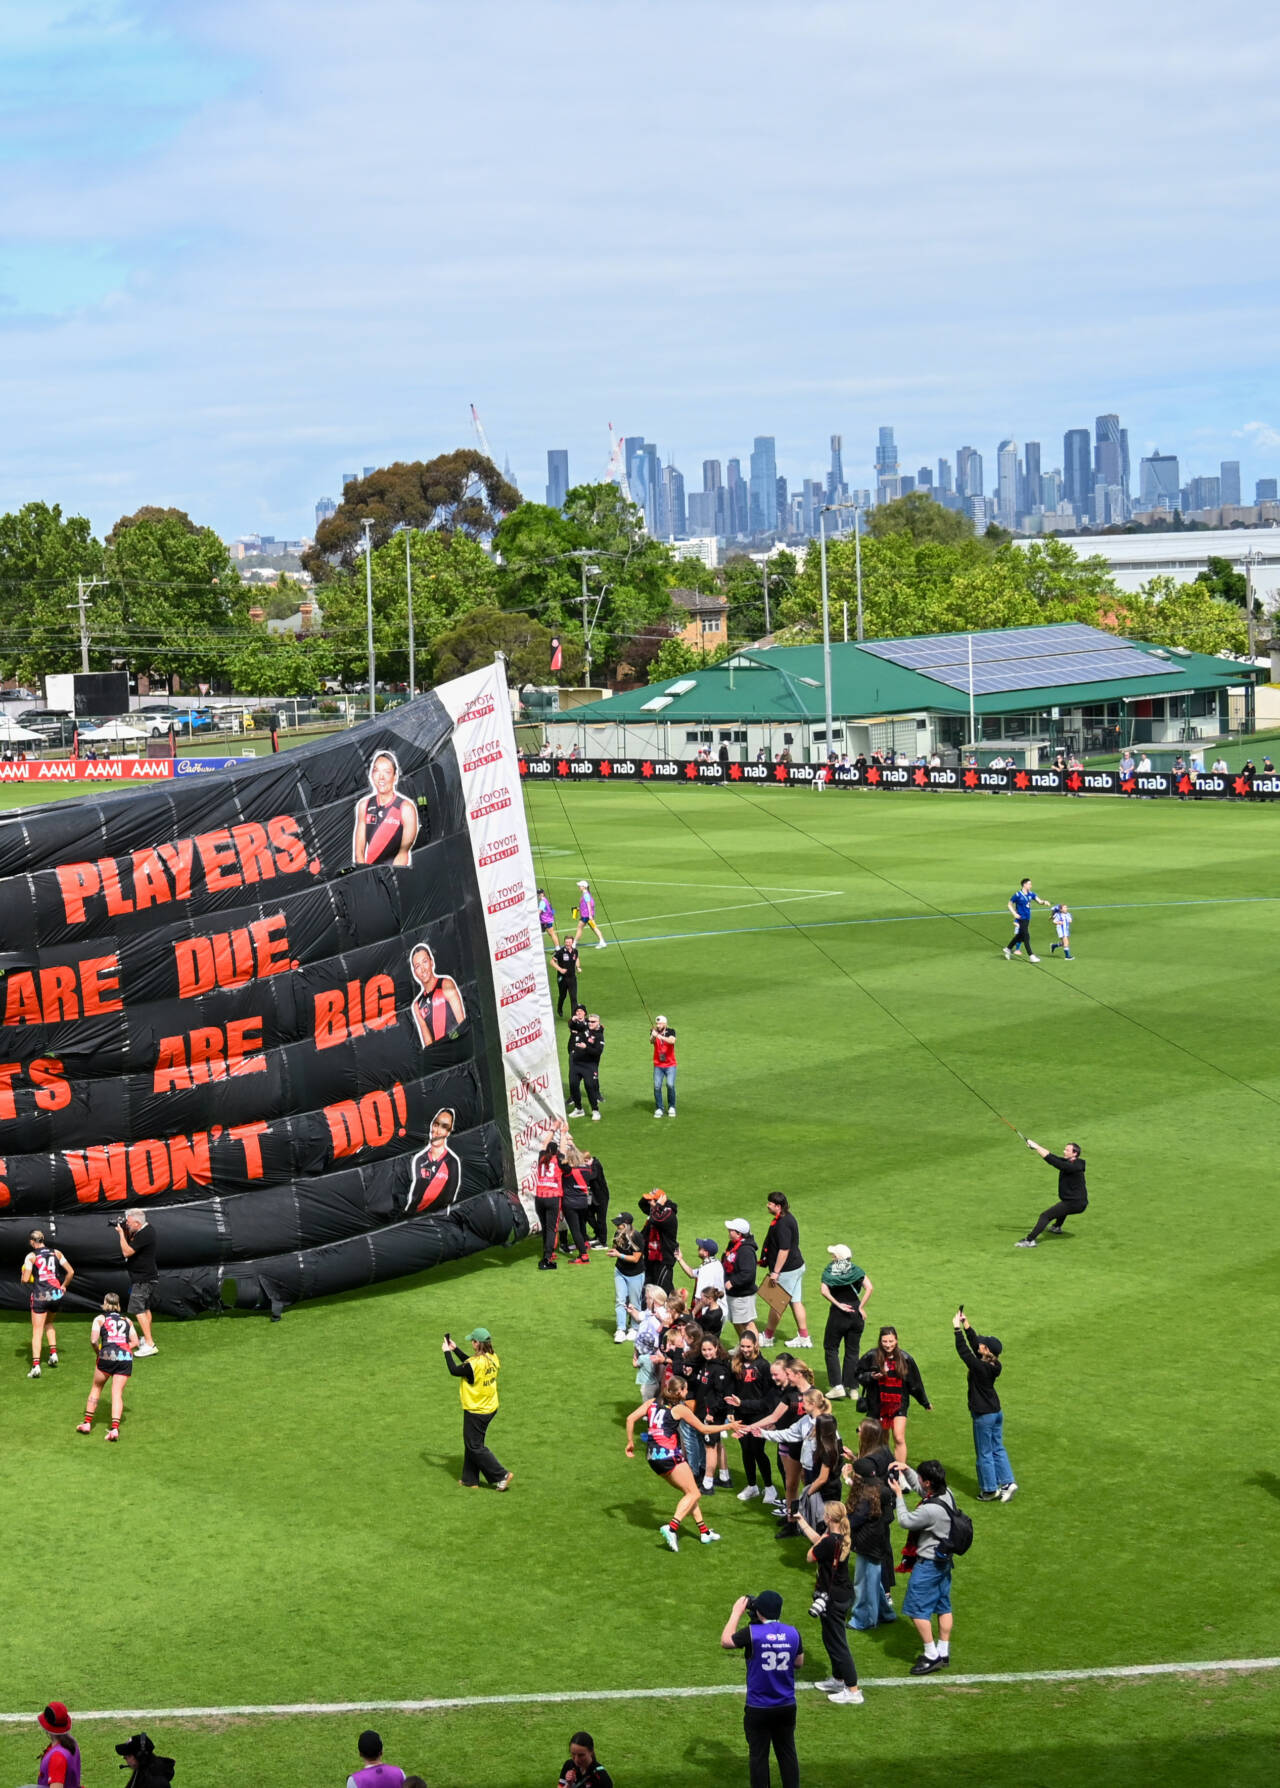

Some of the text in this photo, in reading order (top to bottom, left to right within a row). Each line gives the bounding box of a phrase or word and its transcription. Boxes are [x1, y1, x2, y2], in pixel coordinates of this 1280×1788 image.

[38, 763, 75, 777] AAMI
[85, 762, 122, 777] AAMI
[131, 762, 168, 776] AAMI
[529, 762, 550, 774] nab
[571, 761, 592, 774] nab
[613, 762, 635, 774] nab
[655, 762, 678, 775] nab
[700, 764, 722, 777] nab
[744, 764, 767, 778] nab
[790, 766, 813, 779] nab
[883, 768, 907, 782] nab
[930, 769, 956, 784] nab
[1031, 772, 1059, 787] nab
[1085, 773, 1112, 788] nab
[1138, 775, 1166, 790] nab
[1195, 776, 1224, 791] nab
[1253, 777, 1280, 792] nab
[488, 834, 517, 852] TOYOTA
[56, 815, 321, 924] PLAYERS.
[497, 880, 524, 899] TOYOTA
[504, 928, 529, 946] TOYOTA
[3, 954, 122, 1026] ARE
[175, 914, 300, 1000] DUE.
[511, 972, 536, 990] TOYOTA
[153, 1016, 267, 1093] ARE
[314, 974, 397, 1050] BIG
[515, 1018, 542, 1036] TOYOTA
[510, 1072, 550, 1105] FUJITSU
[64, 1120, 270, 1203] WON'T
[323, 1082, 407, 1159] DO!
[514, 1116, 552, 1150] FUJITSU
[541, 1162, 555, 1177] 13
[38, 1256, 56, 1274] 24
[108, 1319, 126, 1337] 32
[649, 1407, 665, 1428] 14
[761, 1651, 790, 1670] 32
